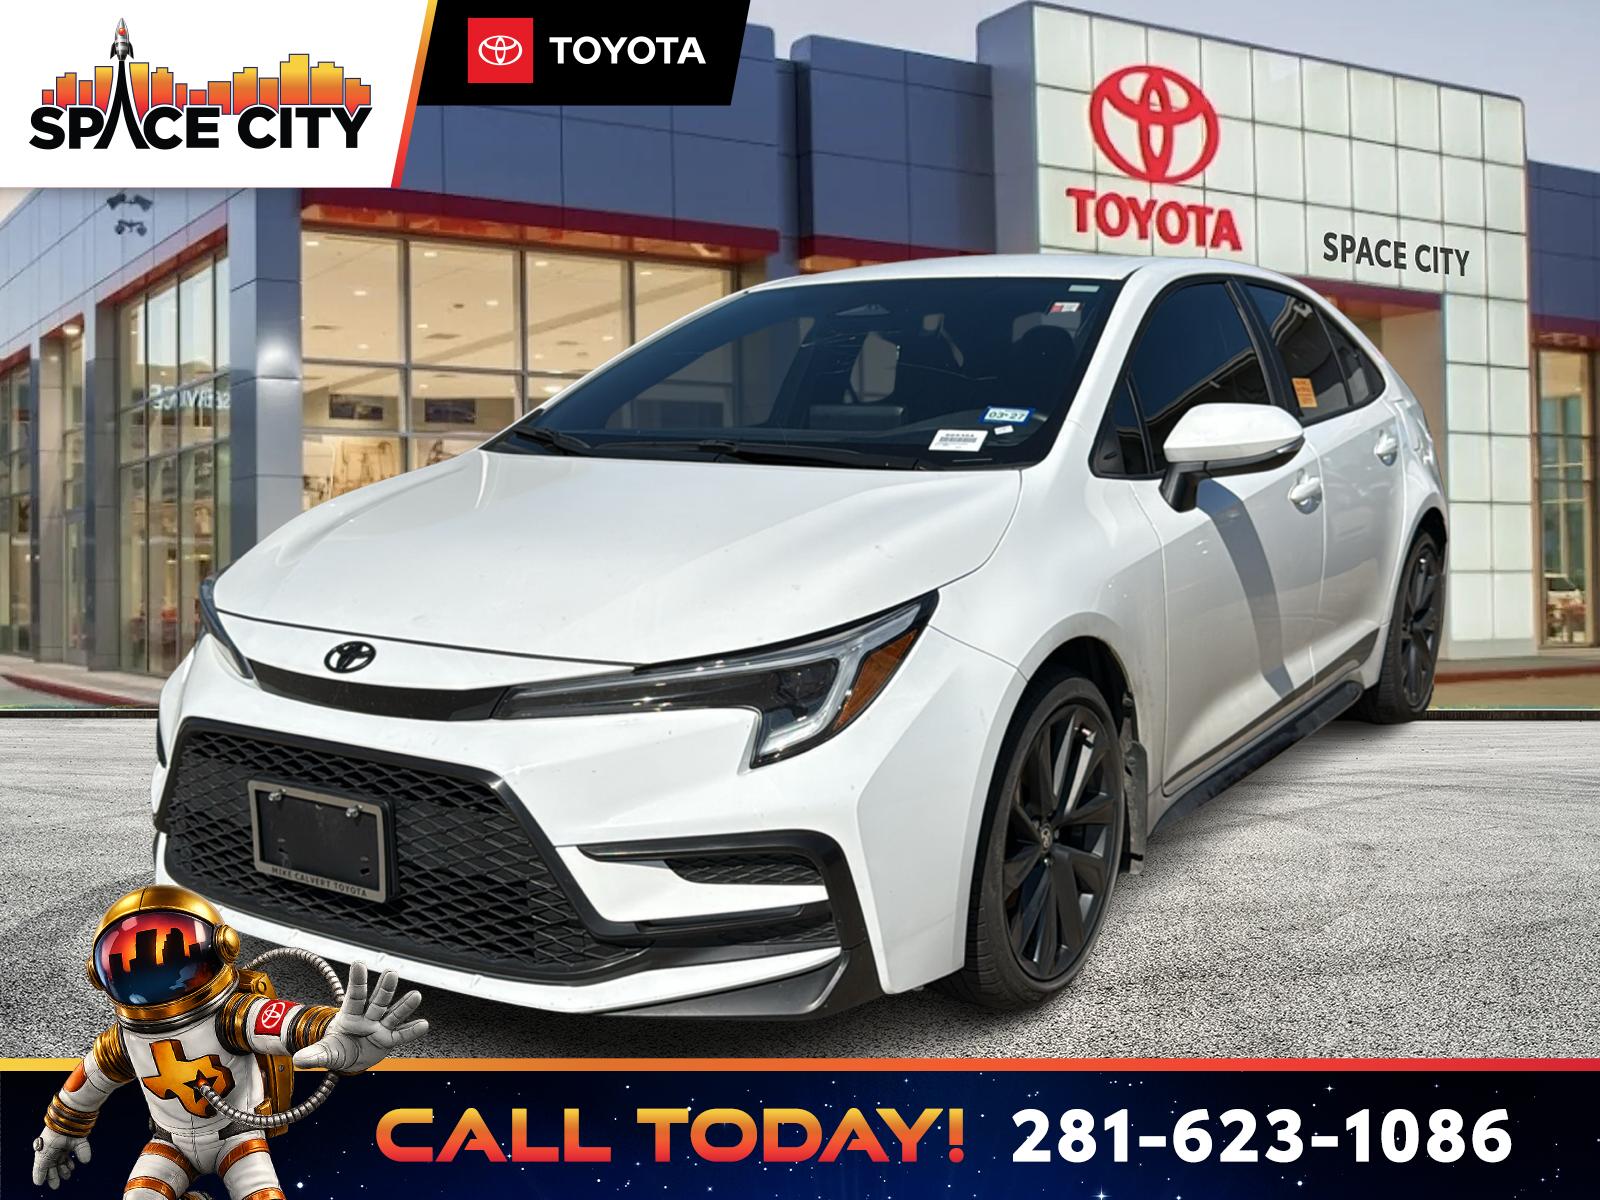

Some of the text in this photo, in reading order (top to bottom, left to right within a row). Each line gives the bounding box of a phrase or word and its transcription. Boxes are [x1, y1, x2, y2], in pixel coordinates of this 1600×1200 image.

[1066, 187, 1242, 251] TOYOTA
[1322, 232, 1470, 276] SPACE CITY
[271, 866, 368, 896] MIKE CALVERT TOYOTA
